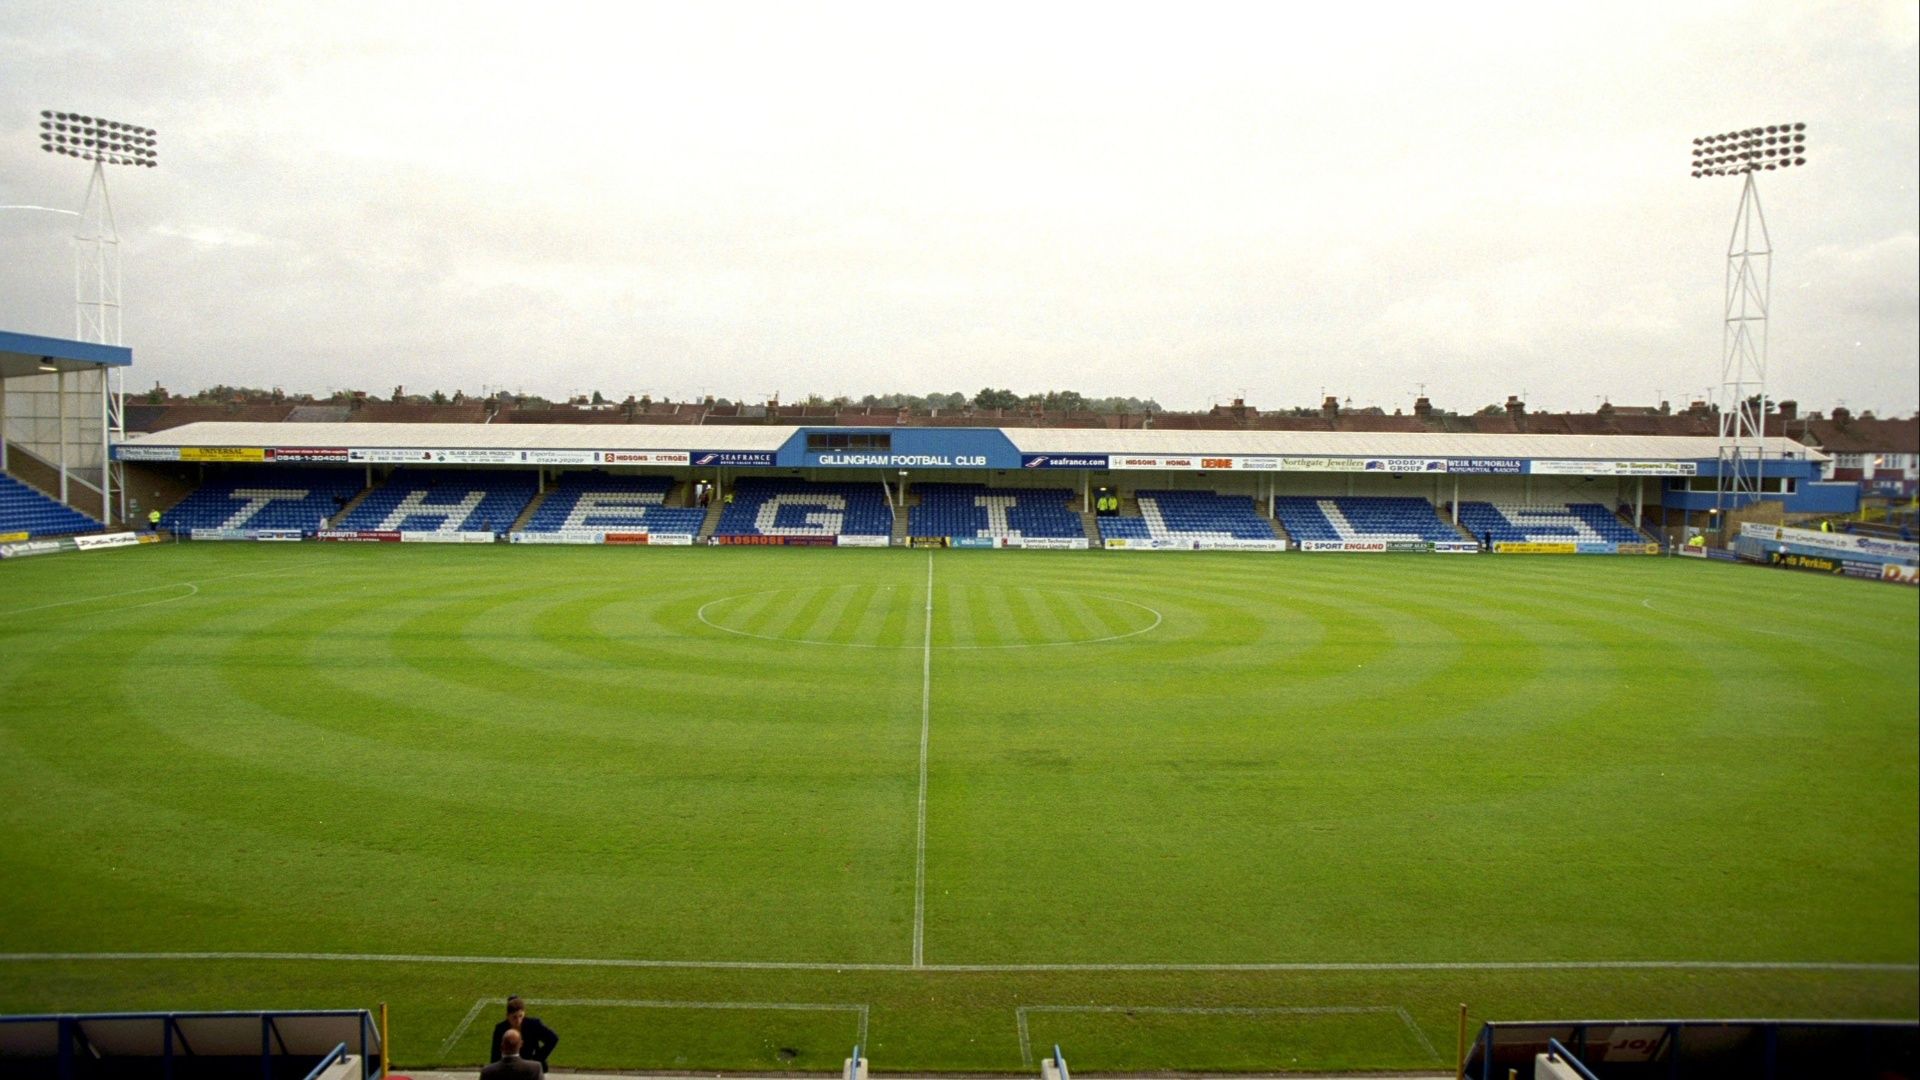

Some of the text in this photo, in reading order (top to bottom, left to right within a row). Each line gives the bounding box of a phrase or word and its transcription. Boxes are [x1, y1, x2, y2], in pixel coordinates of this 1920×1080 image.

[819, 455, 986, 466] GILLINGHAM FOOTBALL CLUB
[1050, 457, 1105, 466] seafrance.com
[1282, 458, 1364, 467] Northgate Jewellers
[1799, 555, 1833, 570] Perkins
